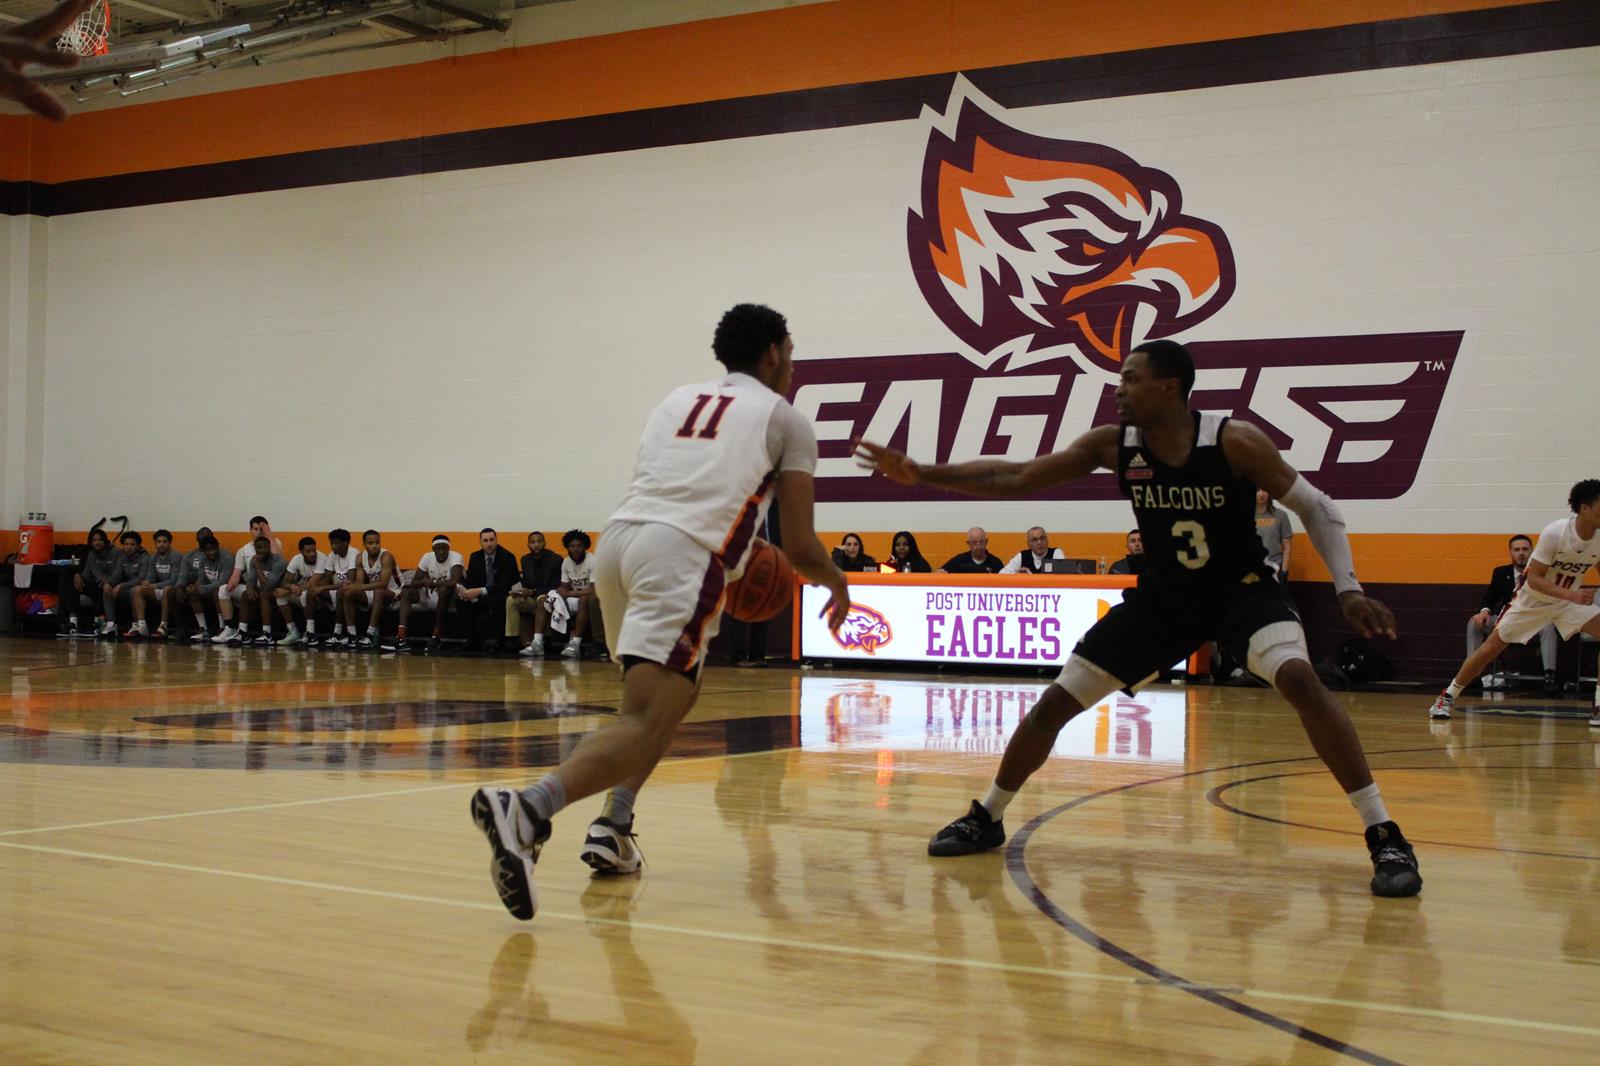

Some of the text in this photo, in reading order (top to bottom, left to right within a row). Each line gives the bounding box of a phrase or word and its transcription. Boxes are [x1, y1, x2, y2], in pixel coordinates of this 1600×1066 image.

[675, 393, 736, 440] 11
[1131, 485, 1225, 510] FALCONS
[1171, 521, 1210, 569] 3
[1552, 560, 1592, 574] POST
[926, 592, 1061, 613] POST UNIVERSITY
[926, 614, 1061, 660] EAGLES
